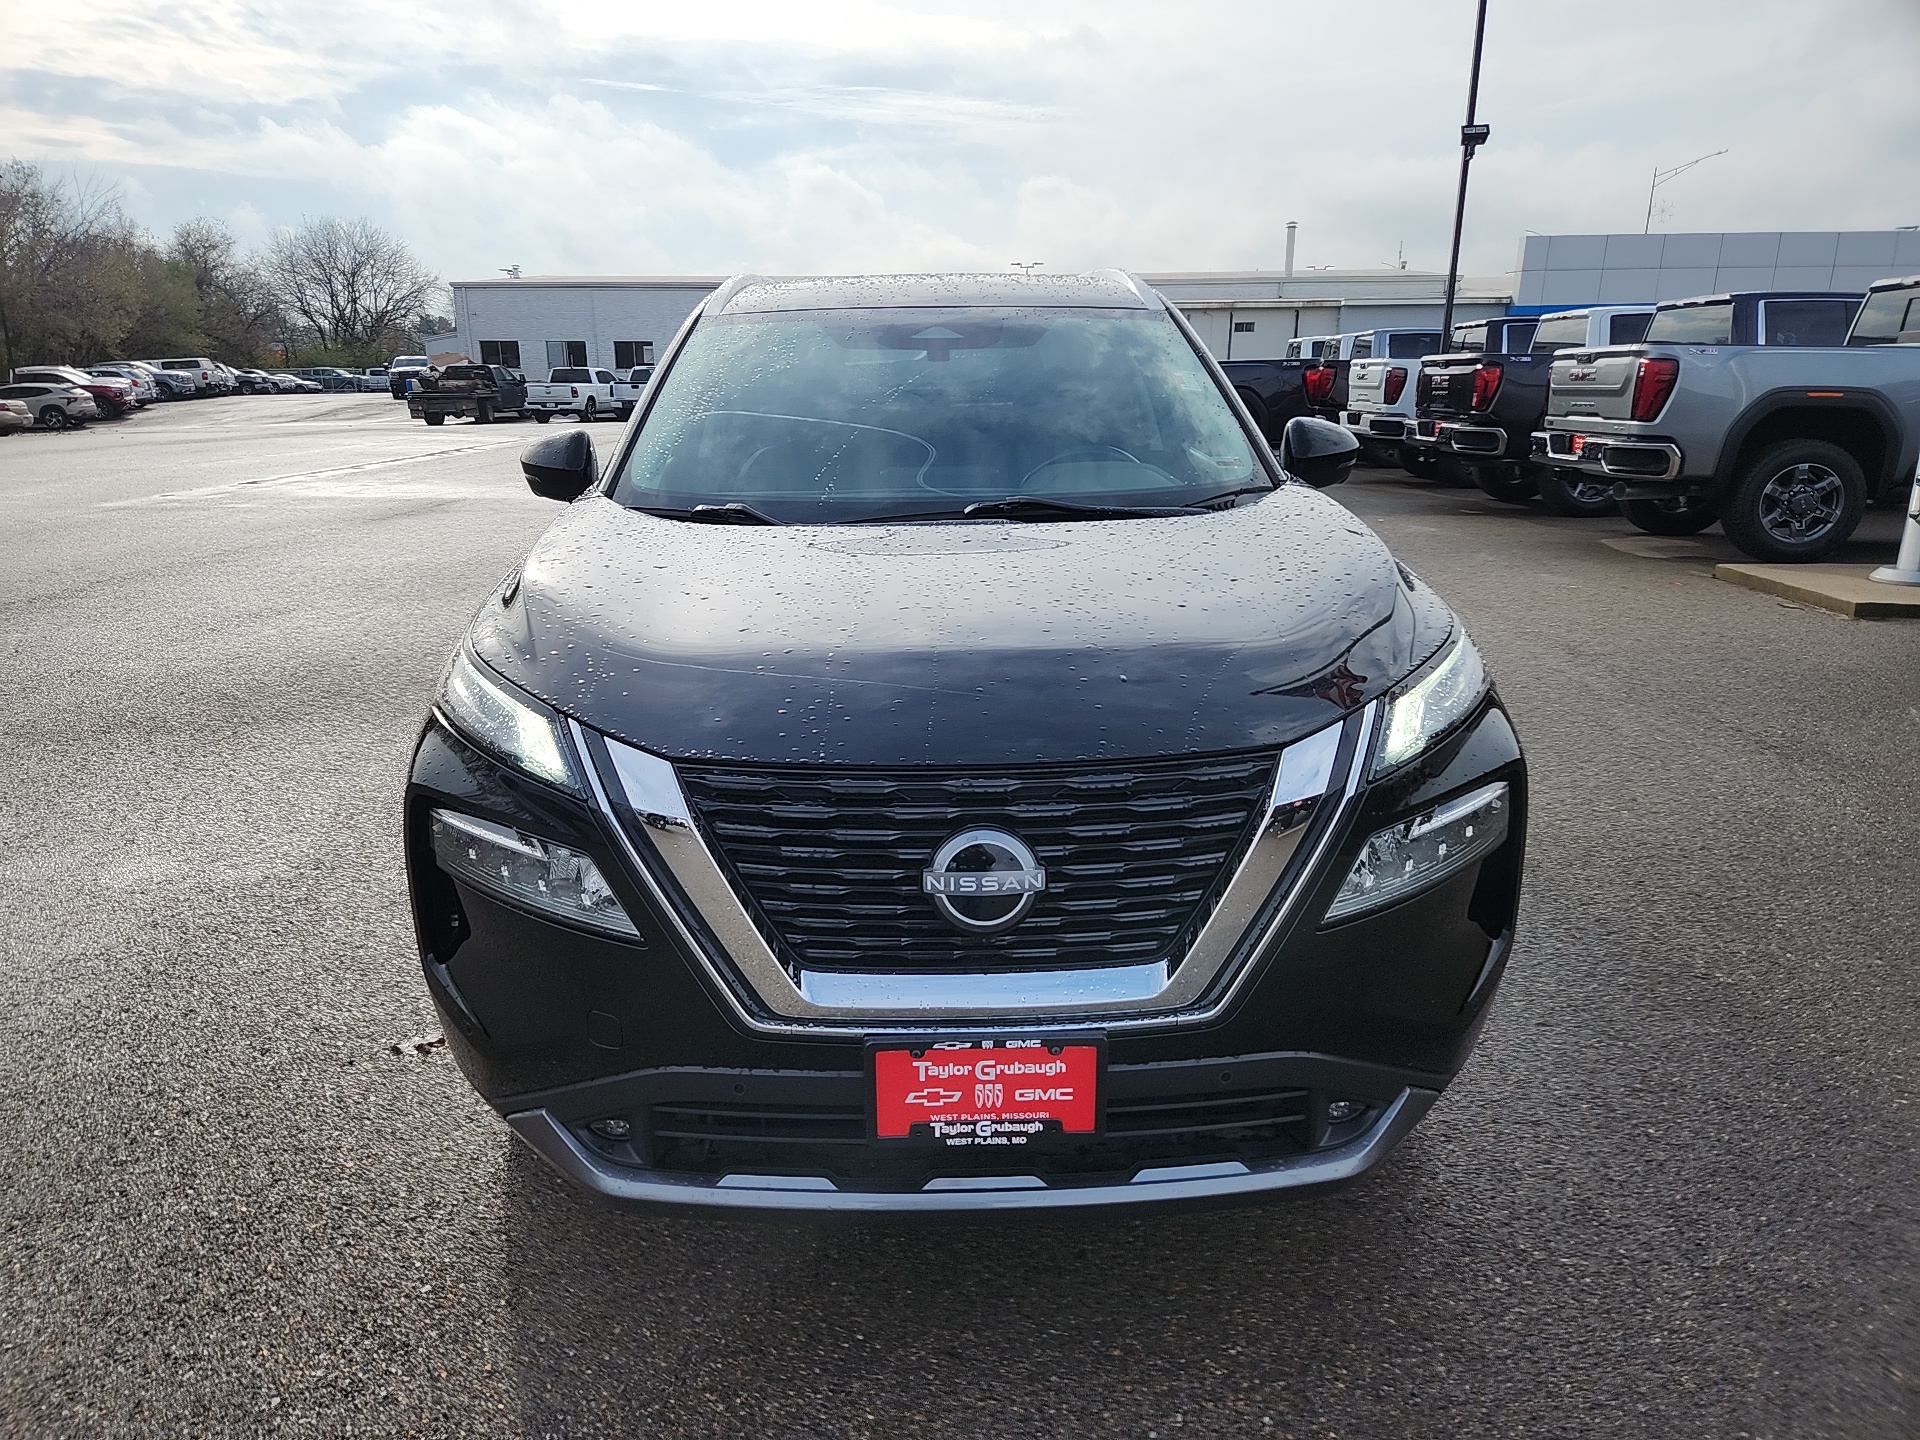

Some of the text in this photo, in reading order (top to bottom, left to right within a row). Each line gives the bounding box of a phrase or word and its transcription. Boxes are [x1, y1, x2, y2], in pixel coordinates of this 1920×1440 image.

[927, 874, 1042, 892] NISSAN
[1005, 1039, 1042, 1049] GMC
[912, 1059, 1067, 1082] Taylor Grubaugh
[1014, 1088, 1074, 1101] GMC
[930, 1111, 1050, 1121] WEST PLAINS, MISSOURI
[929, 1120, 1044, 1137] Taylor Grubaugh
[946, 1136, 1028, 1146] WEST PLAINS, MO
